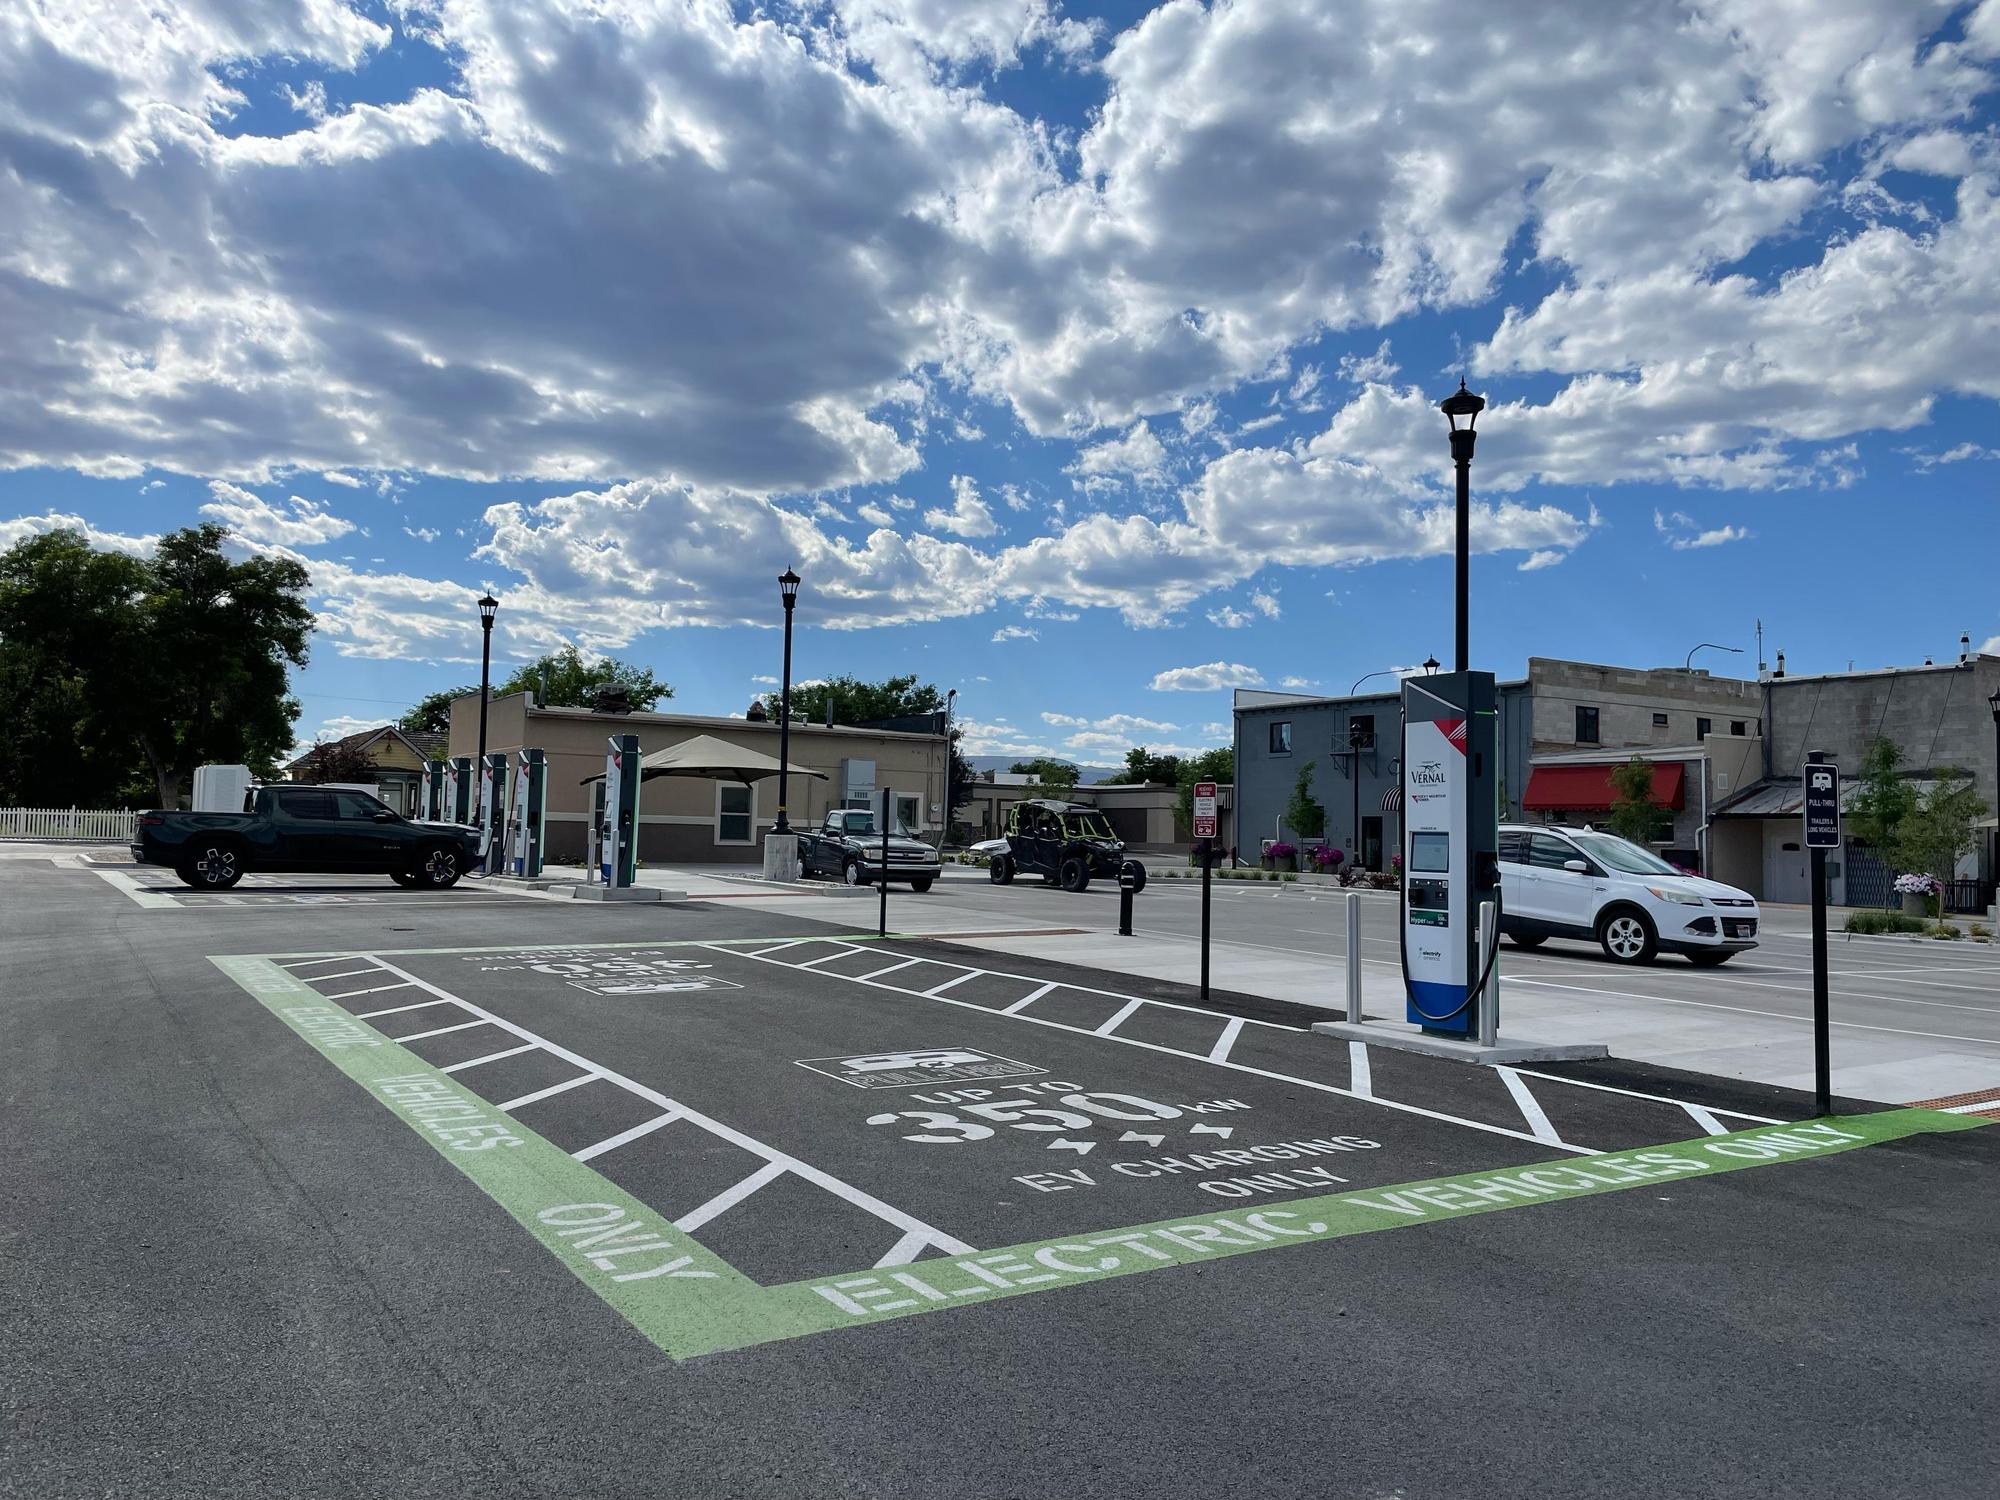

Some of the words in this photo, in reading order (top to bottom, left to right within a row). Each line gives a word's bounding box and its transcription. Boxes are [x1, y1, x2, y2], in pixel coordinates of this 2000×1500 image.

[1411, 771, 1446, 783] VERNAL
[530, 960, 712, 974] 350
[910, 1088, 993, 1104] UP
[1000, 1081, 1084, 1094] TO
[866, 1093, 1183, 1143] 350
[281, 1006, 382, 1048] ELECTRIC
[373, 1073, 525, 1151] VEHICLES
[537, 1203, 720, 1282] ONLY
[1012, 1169, 1096, 1192] EV
[1111, 1135, 1381, 1177] CHARGING
[1198, 1166, 1349, 1197] ONLY
[812, 1210, 1328, 1316] ELECTRIC
[1342, 1152, 1710, 1217] VEHICLES
[1703, 1123, 1865, 1160] ONLY
